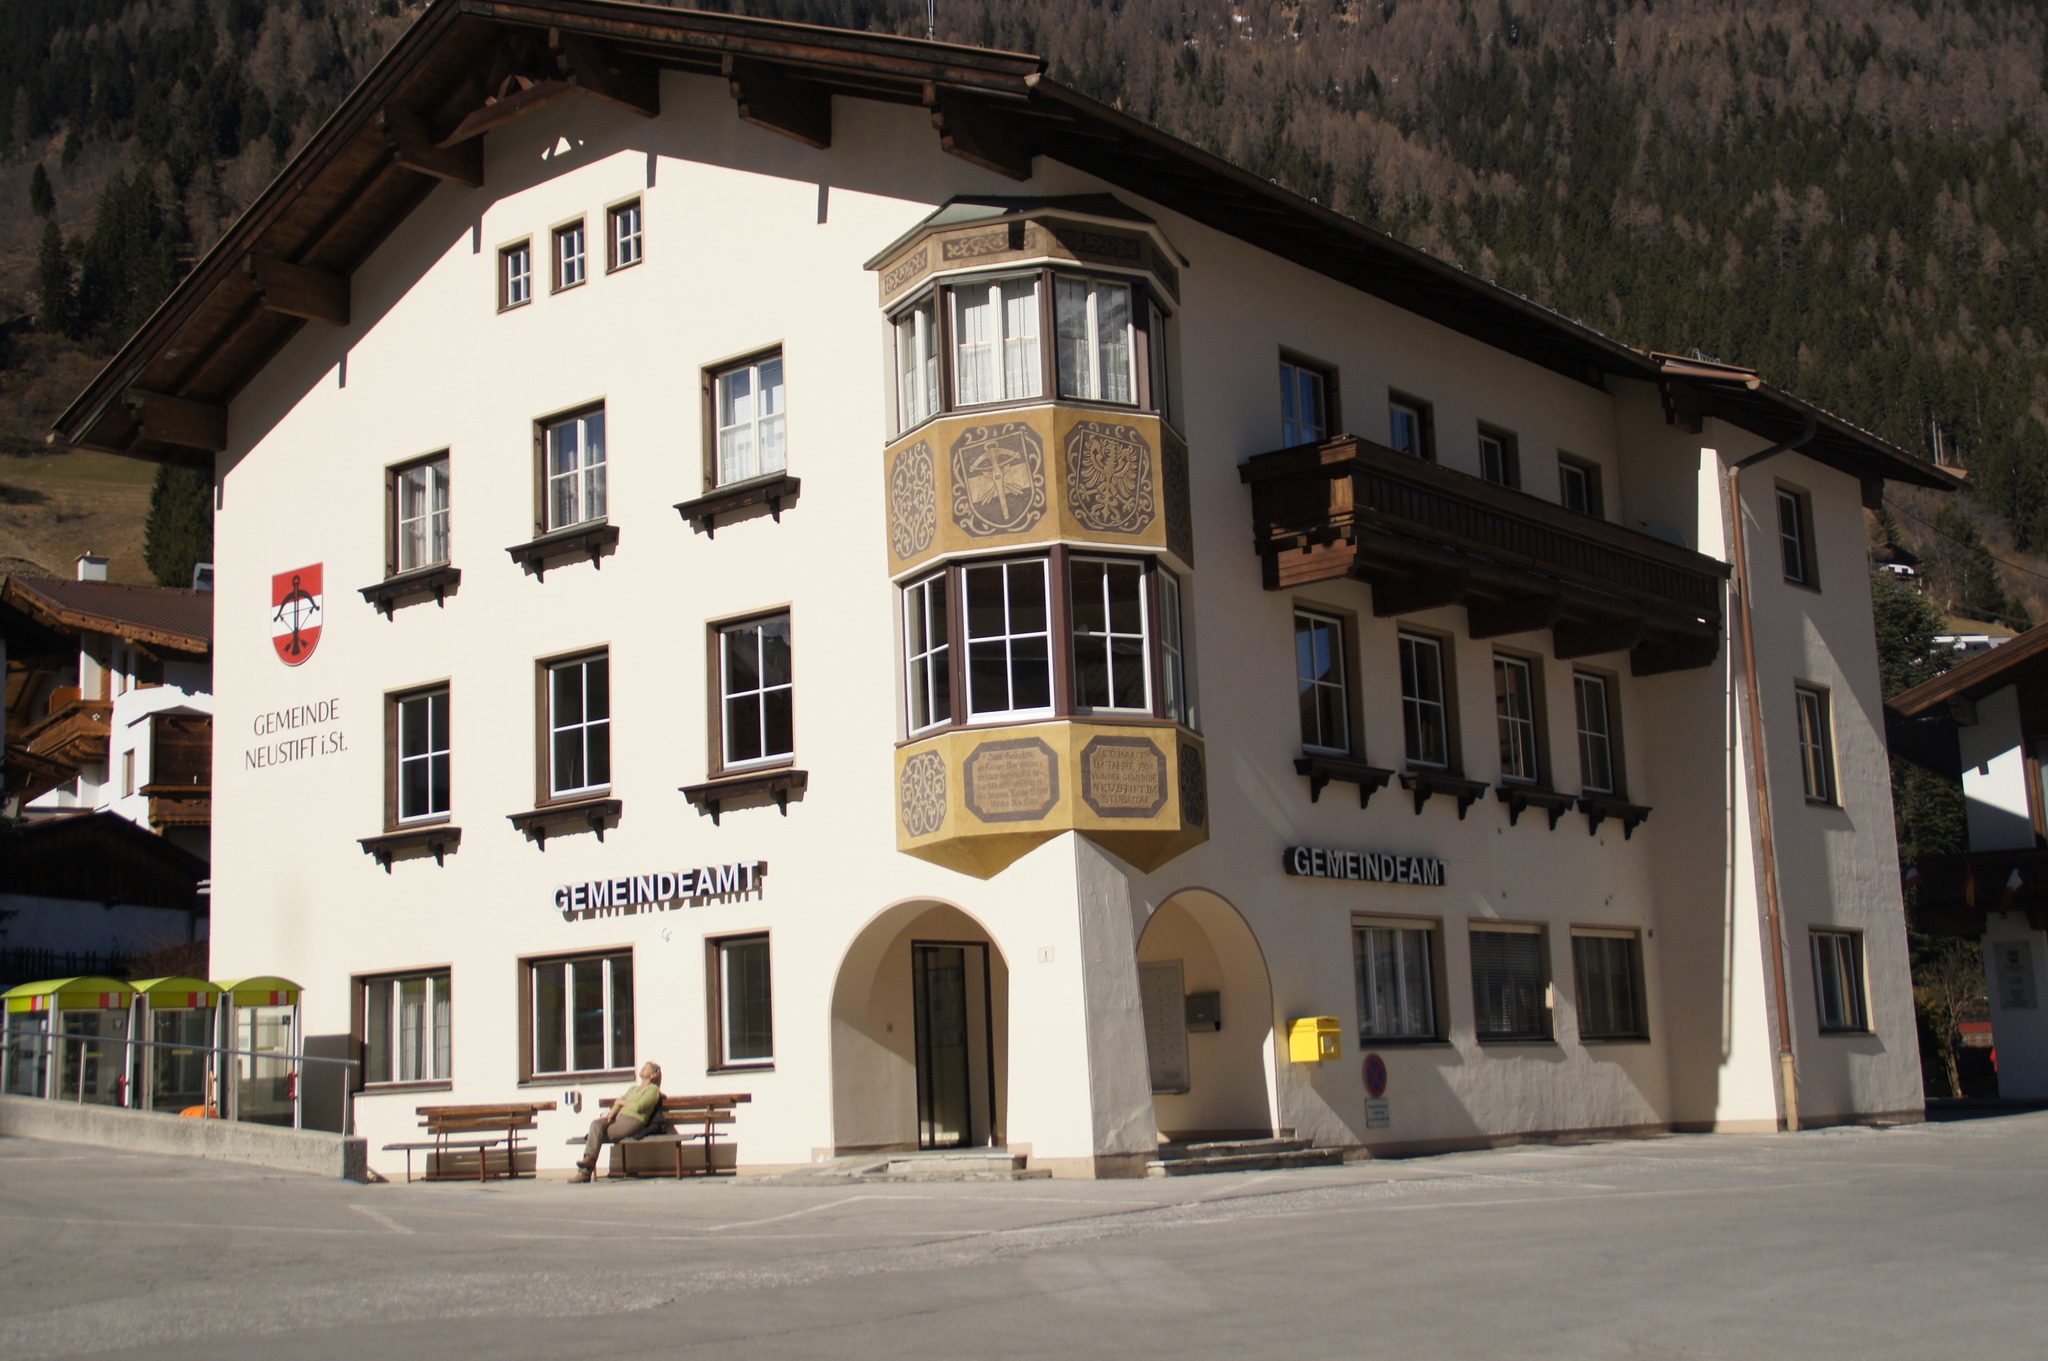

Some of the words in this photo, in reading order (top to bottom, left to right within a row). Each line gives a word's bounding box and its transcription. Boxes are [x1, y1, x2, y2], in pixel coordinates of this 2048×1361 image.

[253, 697, 340, 736] GEMEINDE
[245, 735, 318, 771] NEUSTIFT
[1102, 749, 1145, 760] ERBAUT
[1105, 760, 1135, 771] JAHRE
[1091, 772, 1107, 781] VON
[1122, 773, 1158, 784] GEMEINDE
[1092, 783, 1144, 794] NEUSTIFT
[1102, 794, 1150, 805] STUBAITAL
[1293, 846, 1451, 886] GEMEINDEAMT
[552, 860, 760, 912] GEMEINDEAMT
